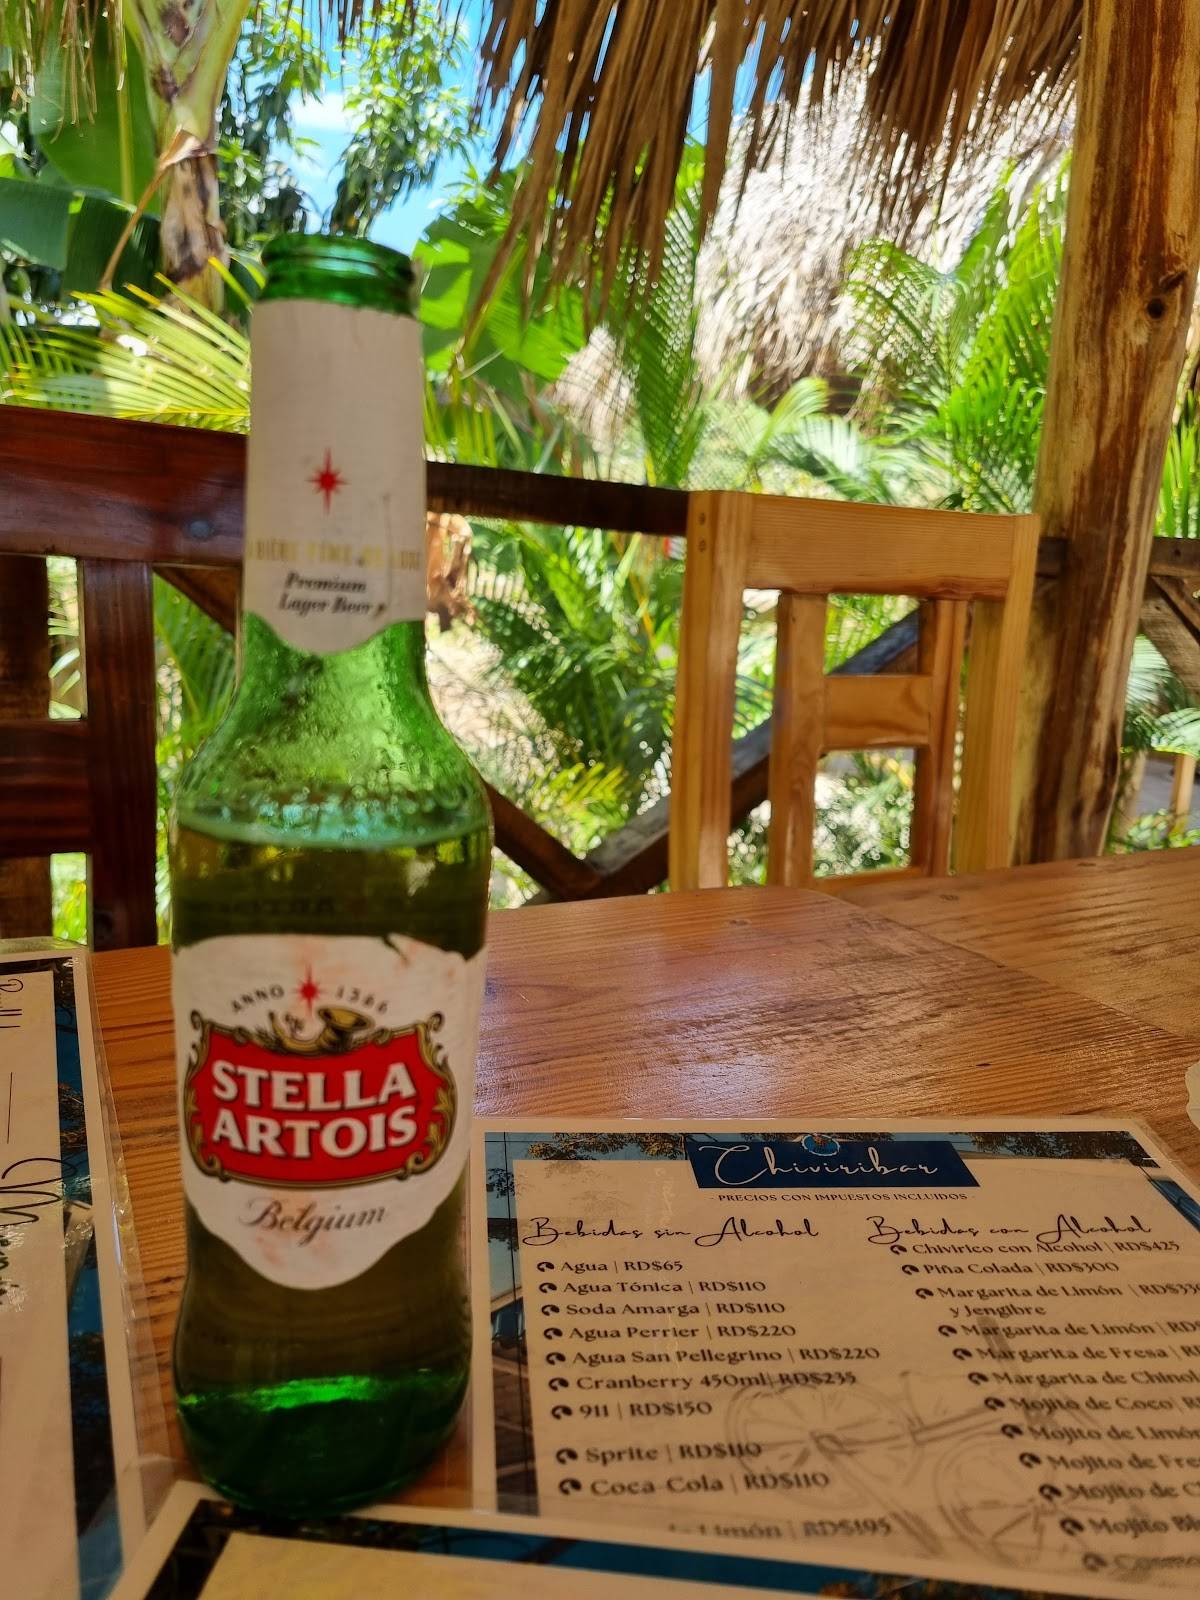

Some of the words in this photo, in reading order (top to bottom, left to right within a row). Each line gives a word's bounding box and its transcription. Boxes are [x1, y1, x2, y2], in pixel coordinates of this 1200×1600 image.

[284, 571, 367, 593] Premium
[278, 593, 329, 616] Lager
[332, 596, 372, 615] Beer
[230, 984, 285, 1013] ANNO
[211, 1059, 417, 1112] STELLA
[211, 1104, 418, 1159] ARTOIS
[698, 1145, 938, 1186] Chiviribar
[718, 1193, 778, 1202] PRECIOS
[781, 1193, 812, 1202] CON
[815, 1193, 890, 1202] IMPUESTOS
[893, 1192, 969, 1201] INCLUIDOS
[243, 1199, 386, 1247] Belgium
[522, 1217, 643, 1246] Bebidas
[654, 1228, 692, 1237] sin
[695, 1217, 819, 1247] Alcohol
[867, 1215, 979, 1245] Bebidas
[1036, 1214, 1152, 1244] Alcohol
[912, 1244, 994, 1254] Chivirico
[999, 1245, 1032, 1254] con
[1037, 1241, 1103, 1253] Alcohol
[1114, 1240, 1180, 1251] RD$425
[560, 1261, 608, 1274] Agua
[624, 1260, 684, 1272] RD$65
[923, 1262, 964, 1275] Piña
[968, 1262, 1033, 1274] Colada
[1046, 1262, 1120, 1274] RD$300
[563, 1282, 613, 1295] Agua
[617, 1280, 683, 1293] Tónica
[699, 1281, 766, 1292] RD$110
[937, 1287, 1032, 1301] Margarita
[1036, 1286, 1060, 1298] de
[1064, 1284, 1123, 1297] Limón
[566, 1302, 616, 1315] Soda
[622, 1303, 700, 1317] Amarga
[717, 1302, 786, 1314] RD$110
[950, 1306, 960, 1318] y
[964, 1304, 1047, 1318] Jengibre
[569, 1326, 621, 1342] Agua
[627, 1326, 700, 1338] Perrier
[717, 1325, 796, 1337] RD$220
[962, 1323, 1060, 1338] Margarita
[1063, 1323, 1088, 1336] de
[1092, 1321, 1156, 1336] Limón
[572, 1350, 626, 1367] Agua
[632, 1350, 670, 1363] San
[676, 1349, 782, 1366] Pellegrino
[800, 1347, 880, 1360] RD$220
[977, 1348, 1079, 1363] Margarita
[1083, 1347, 1107, 1360] de
[1110, 1346, 1169, 1359] Fresa
[577, 1374, 692, 1390] Cranberry
[700, 1372, 767, 1387] 450ml
[778, 1370, 857, 1385] RD$235
[992, 1371, 1097, 1387] Margarita
[1102, 1370, 1127, 1384] de
[1130, 1369, 1200, 1384] Chinol
[580, 1405, 609, 1418] 911
[629, 1402, 712, 1416] RD$150
[1009, 1396, 1081, 1415] Mojito
[1088, 1396, 1113, 1411] de
[1115, 1398, 1173, 1411] Coco
[1028, 1425, 1102, 1445] Mojito
[1107, 1425, 1135, 1440] de
[586, 1446, 658, 1466] Sprite
[679, 1443, 762, 1459] RD$110
[1047, 1454, 1123, 1474] Mojito
[1127, 1453, 1158, 1469] de
[590, 1479, 655, 1496] Coca
[666, 1474, 724, 1493] Cola
[744, 1472, 830, 1490] RD$110
[1065, 1483, 1145, 1504] Mojito
[1150, 1481, 1180, 1498] de
